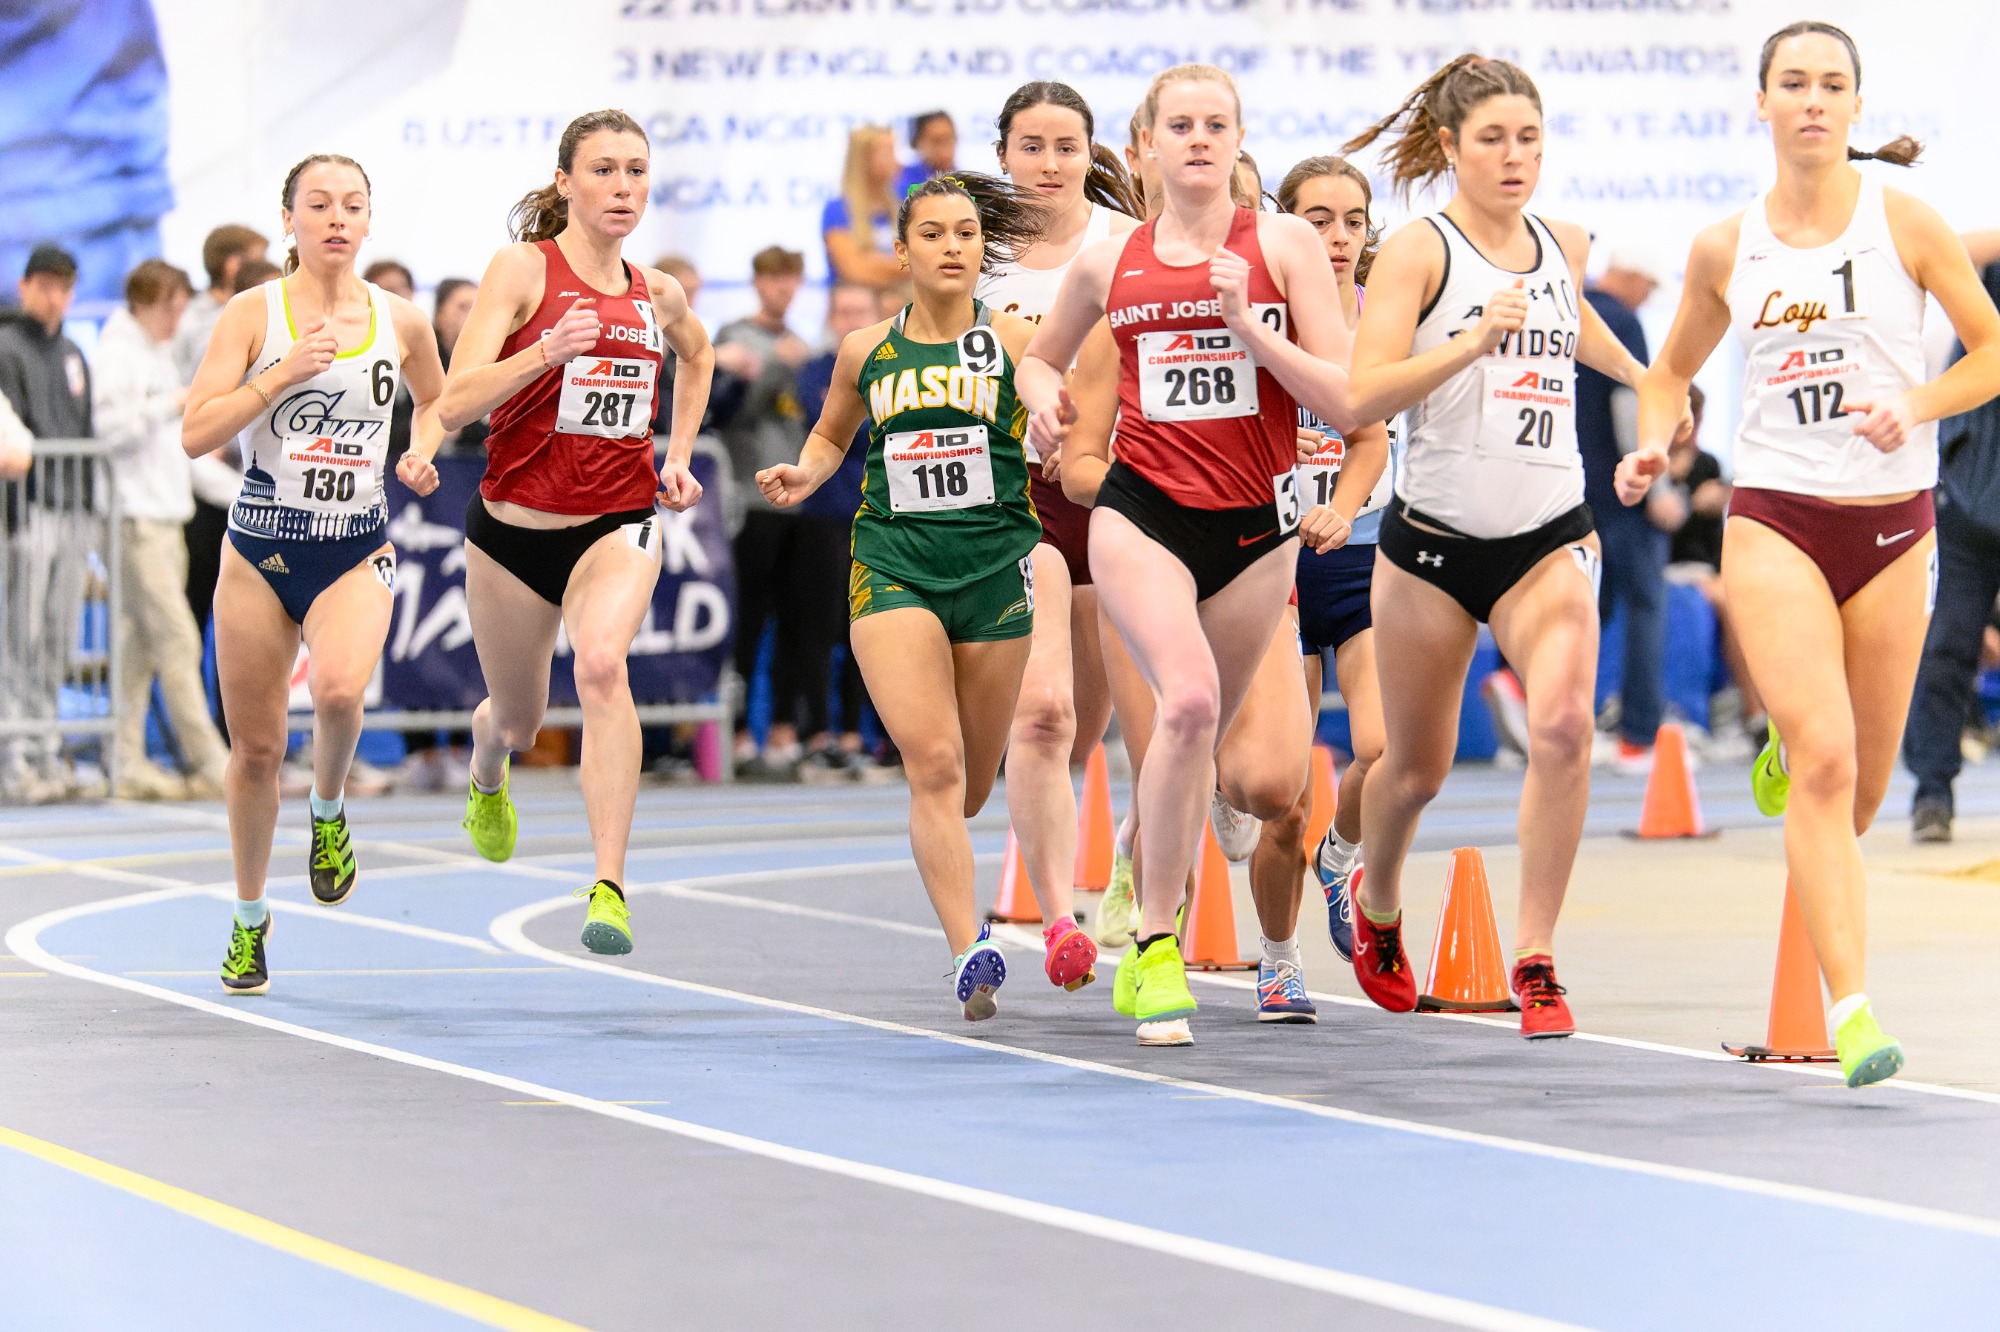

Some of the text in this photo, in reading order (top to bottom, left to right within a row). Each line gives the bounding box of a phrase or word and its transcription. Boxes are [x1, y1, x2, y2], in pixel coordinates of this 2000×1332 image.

[1832, 260, 1855, 312] 1
[1109, 299, 1222, 329] SAINT JOSE
[1753, 290, 1827, 333] Loy
[606, 325, 647, 346] JOSE
[1164, 333, 1231, 352] A10
[1448, 328, 1576, 359] VIDSO
[874, 353, 898, 362] adidas
[963, 329, 997, 373] 9
[1148, 350, 1247, 365] CHAMPIONSHIPS
[1780, 350, 1844, 371] A10
[587, 360, 641, 378] A10
[371, 359, 394, 407] 6
[571, 376, 649, 390] CHAMPIONSHIPS
[1164, 366, 1236, 407] 268
[1511, 371, 1563, 392] A10
[869, 365, 1000, 428] MASON
[1493, 389, 1571, 407] CHAMPIONSHIPS
[1787, 381, 1849, 425] 172
[582, 391, 636, 427] 287
[1515, 407, 1554, 449] 20
[305, 437, 363, 456] A10
[907, 432, 969, 450] A10
[289, 452, 372, 468] CHAMPIONSHIPS
[891, 446, 984, 462] CHAMPIONSHIPS
[301, 468, 356, 502] 130
[912, 461, 969, 499] 118
[258, 562, 290, 574] adidas
